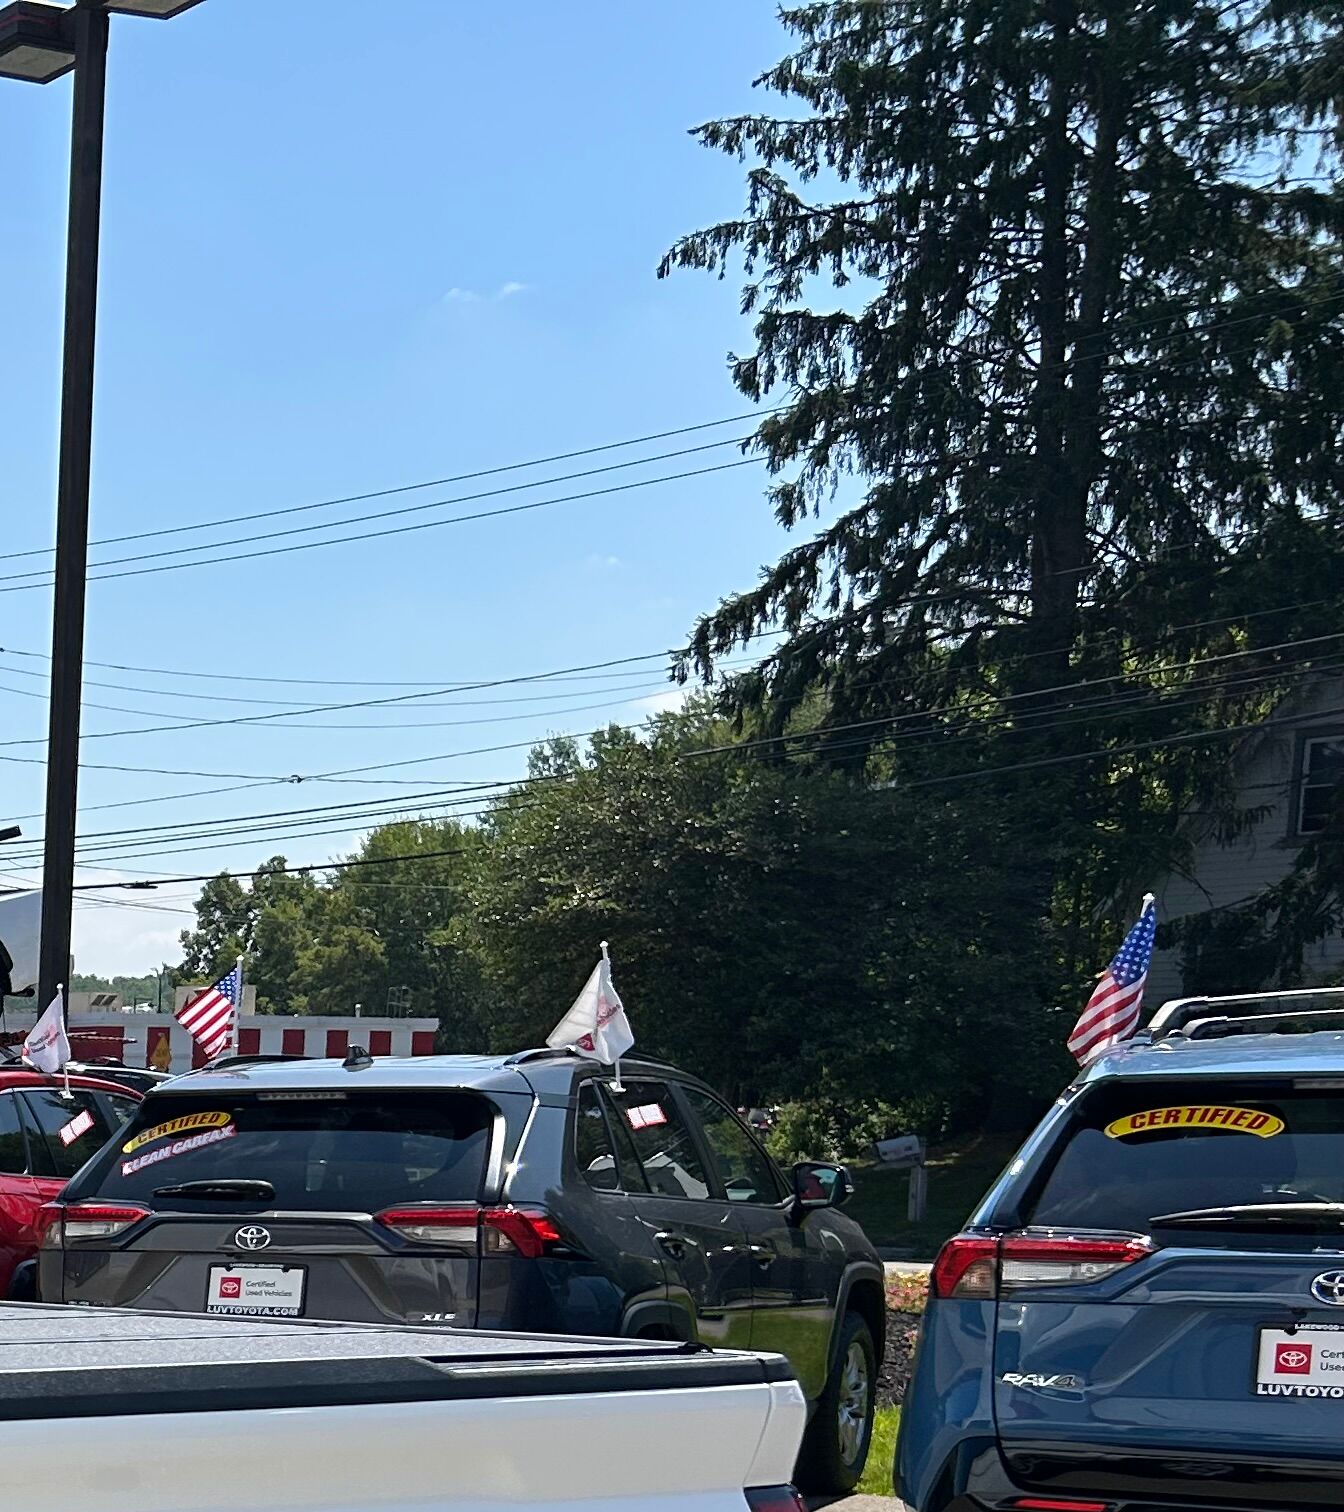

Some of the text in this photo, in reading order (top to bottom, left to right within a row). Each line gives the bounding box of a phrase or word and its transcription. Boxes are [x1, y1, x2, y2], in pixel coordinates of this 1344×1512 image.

[1130, 1107, 1271, 1130] CERTIFIED
[137, 1112, 222, 1144] CERTIFIED
[172, 1124, 235, 1155] CARFAX
[245, 1280, 276, 1288] Certified
[206, 1305, 299, 1316] LUVTOYOTA.COM
[1001, 1372, 1076, 1388] RAV4
[1256, 1383, 1344, 1398] LUVTOYO
